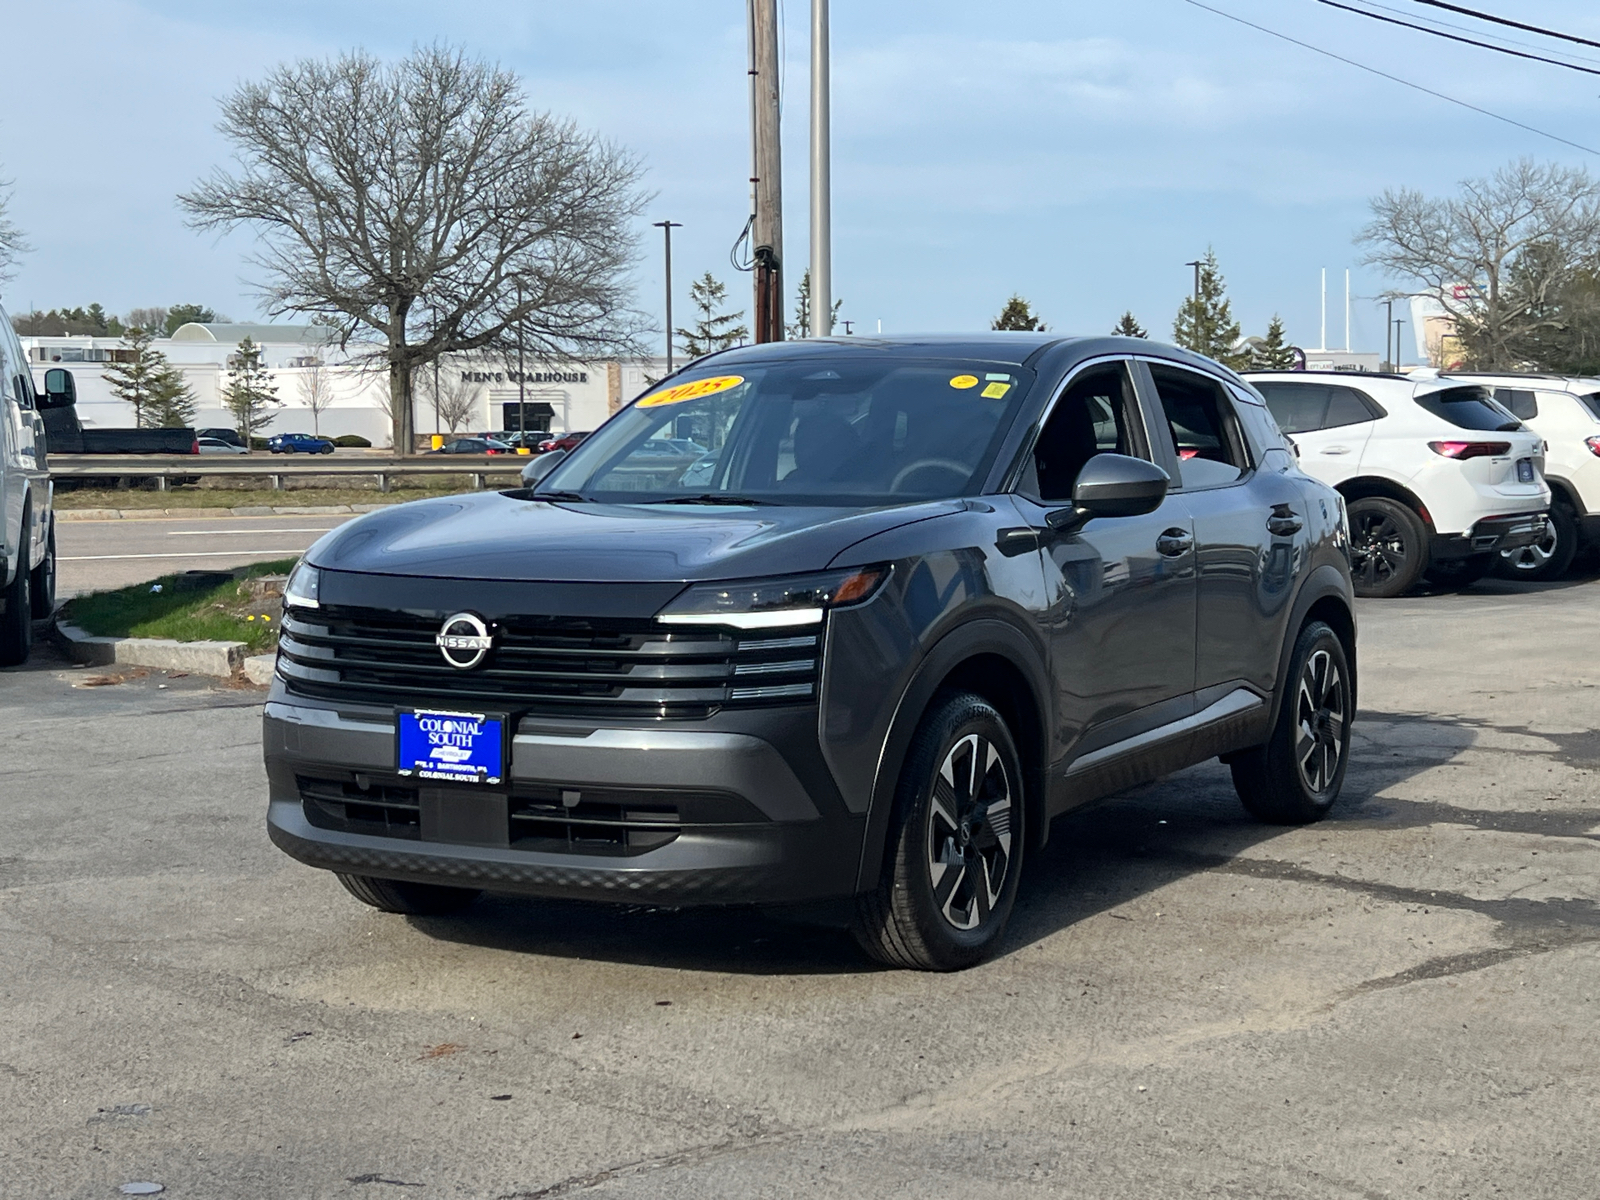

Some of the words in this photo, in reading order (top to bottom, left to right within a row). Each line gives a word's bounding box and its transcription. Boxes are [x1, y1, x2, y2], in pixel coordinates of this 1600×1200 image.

[461, 371, 503, 382] MEN'S
[651, 378, 730, 404] 2025
[436, 637, 490, 648] NISSAN
[419, 719, 483, 735] COLONIAL
[428, 732, 472, 747] SOUTH
[419, 770, 455, 780] COLONIAL
[455, 774, 479, 783] SOUTH
